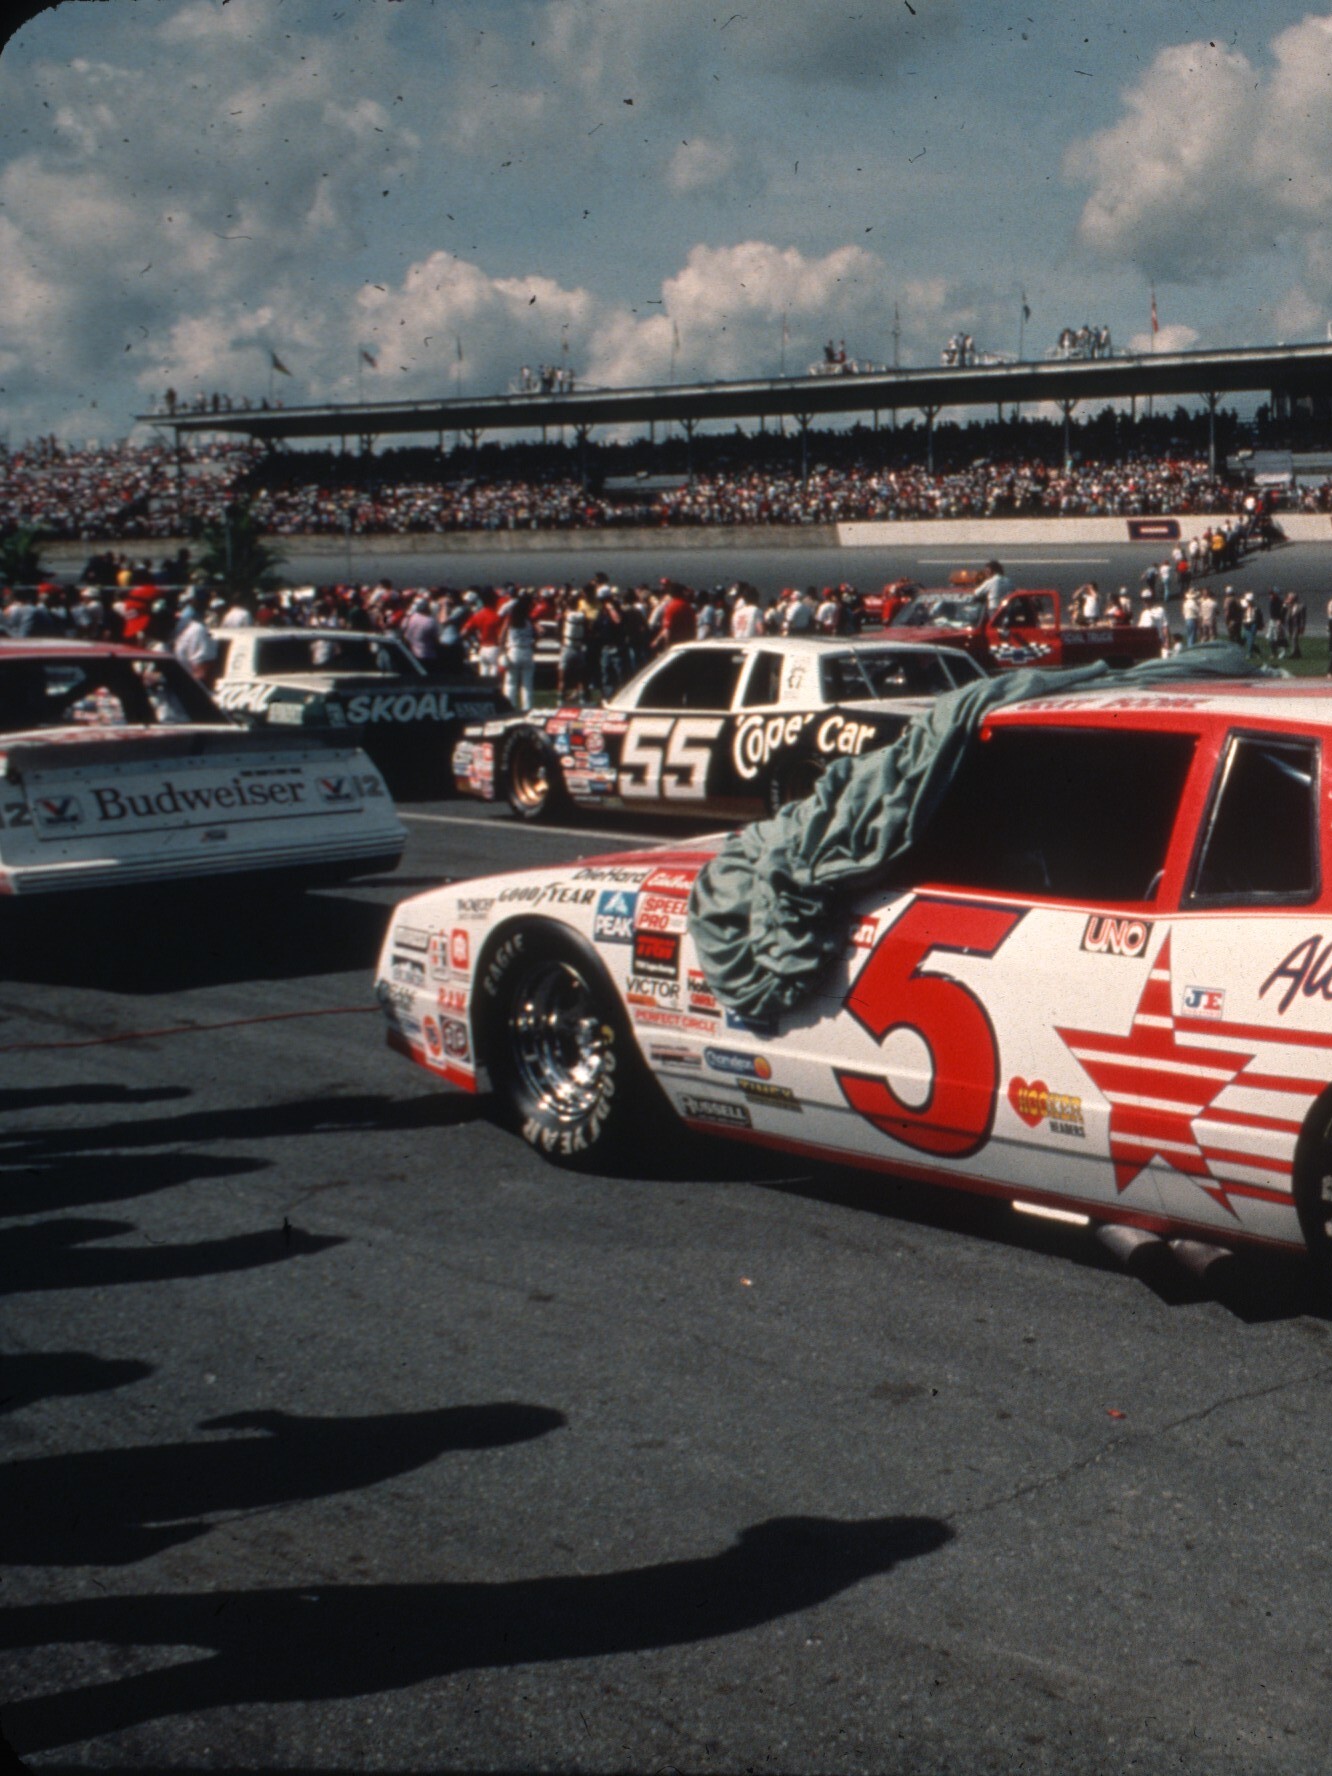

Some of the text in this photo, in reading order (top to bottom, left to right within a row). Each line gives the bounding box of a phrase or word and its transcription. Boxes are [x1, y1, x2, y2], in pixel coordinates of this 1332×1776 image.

[346, 693, 456, 723] SKOAL
[618, 717, 725, 798] 55
[817, 716, 876, 755] Car
[89, 774, 308, 822] Budweiser
[597, 916, 633, 937] PEAK
[639, 914, 669, 929] PRO
[1083, 915, 1149, 957] UNO
[484, 933, 524, 997] EAGLE
[626, 977, 681, 999] VICTOR
[1185, 989, 1223, 1011] JE
[635, 1009, 716, 1033] PERFECT CIRCLE
[832, 896, 1031, 1159] 5
[1018, 1088, 1085, 1124] HOOKER
[1049, 1120, 1086, 1138] HEADERS
